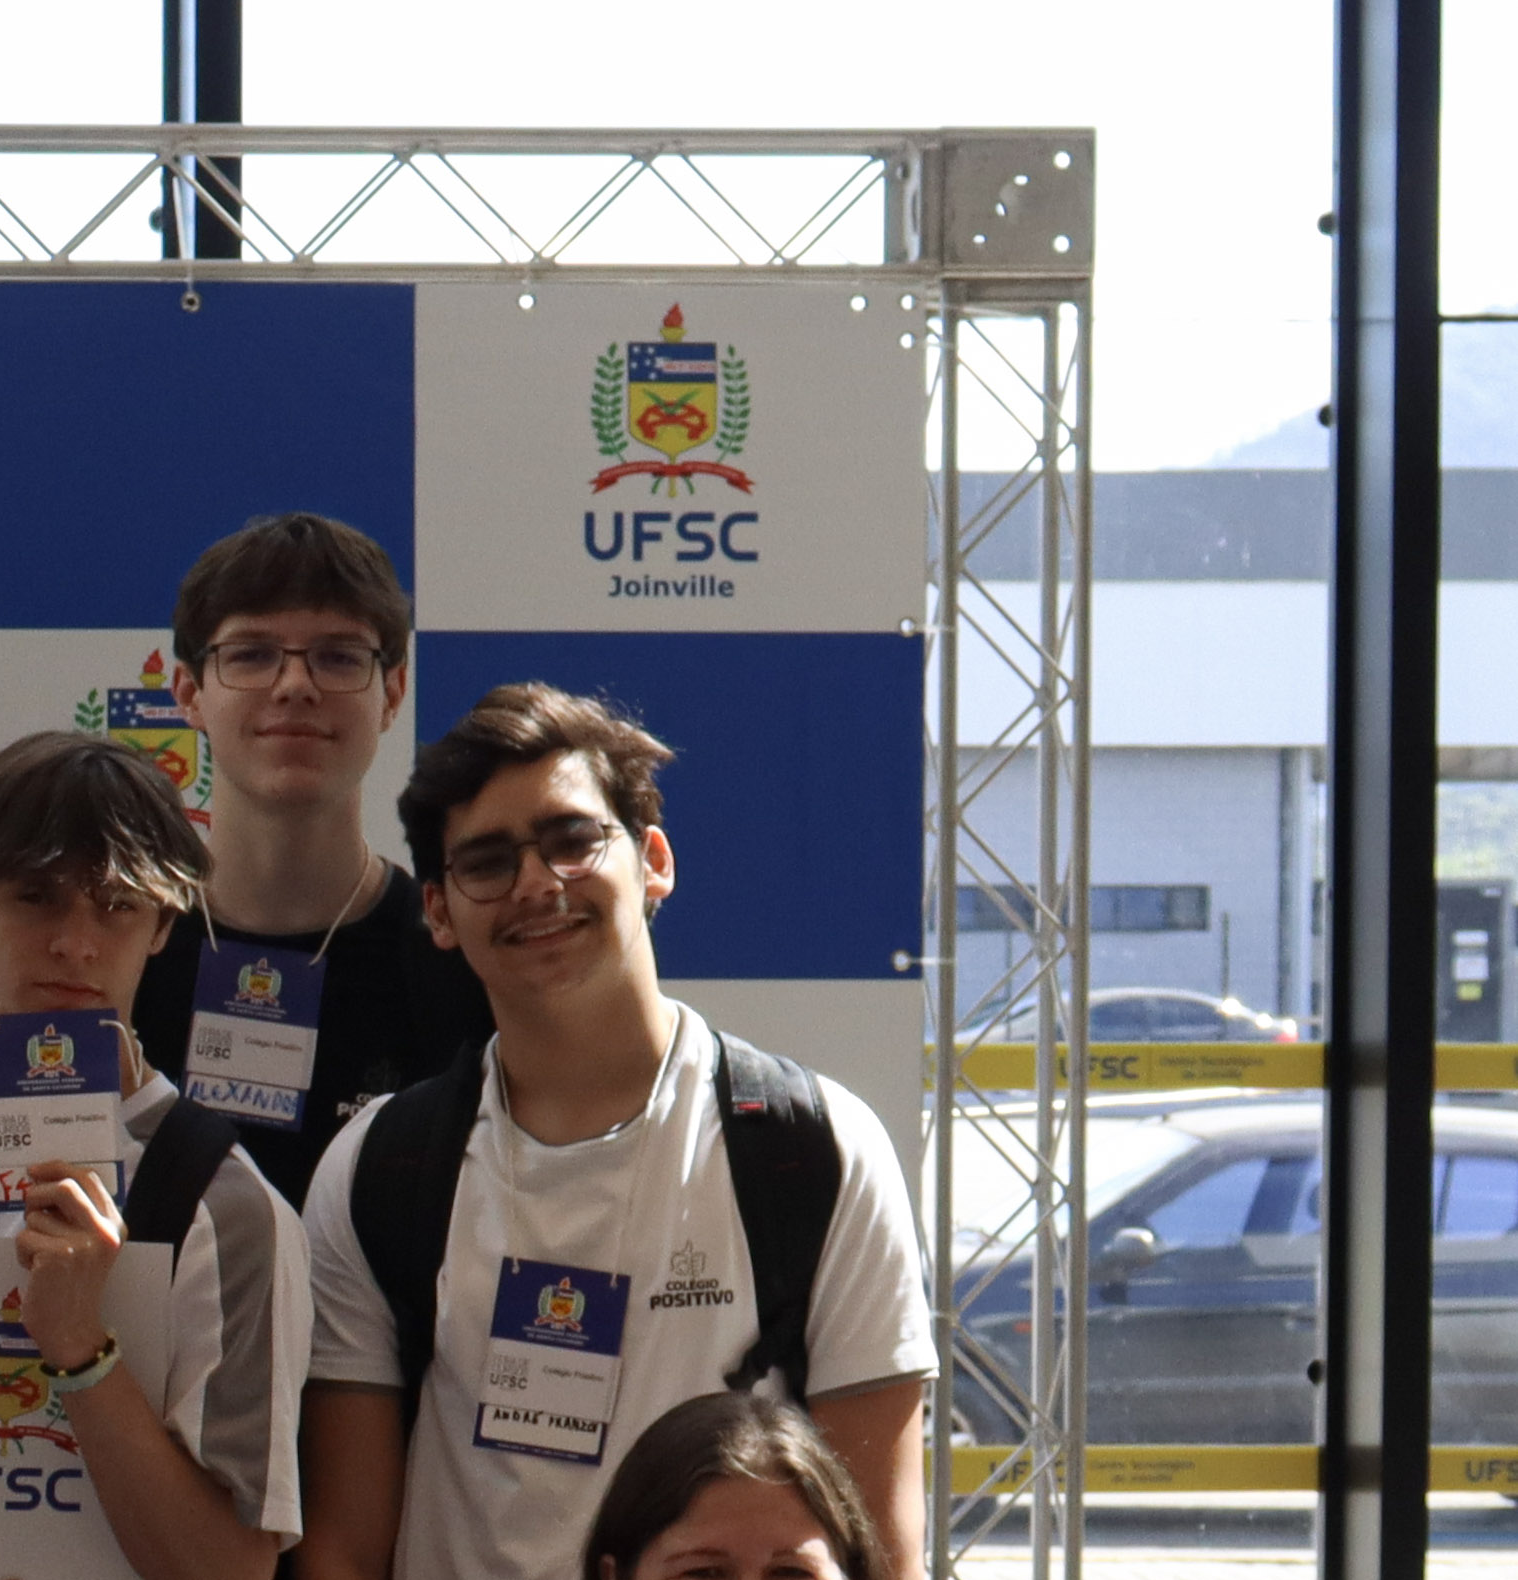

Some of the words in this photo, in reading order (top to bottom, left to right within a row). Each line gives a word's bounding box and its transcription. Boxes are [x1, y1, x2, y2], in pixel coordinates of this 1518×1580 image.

[583, 511, 759, 562] UFSC
[607, 575, 735, 598] Joinville
[650, 1289, 734, 1311] POSITIVO
[1465, 1459, 1518, 1482] UFS
